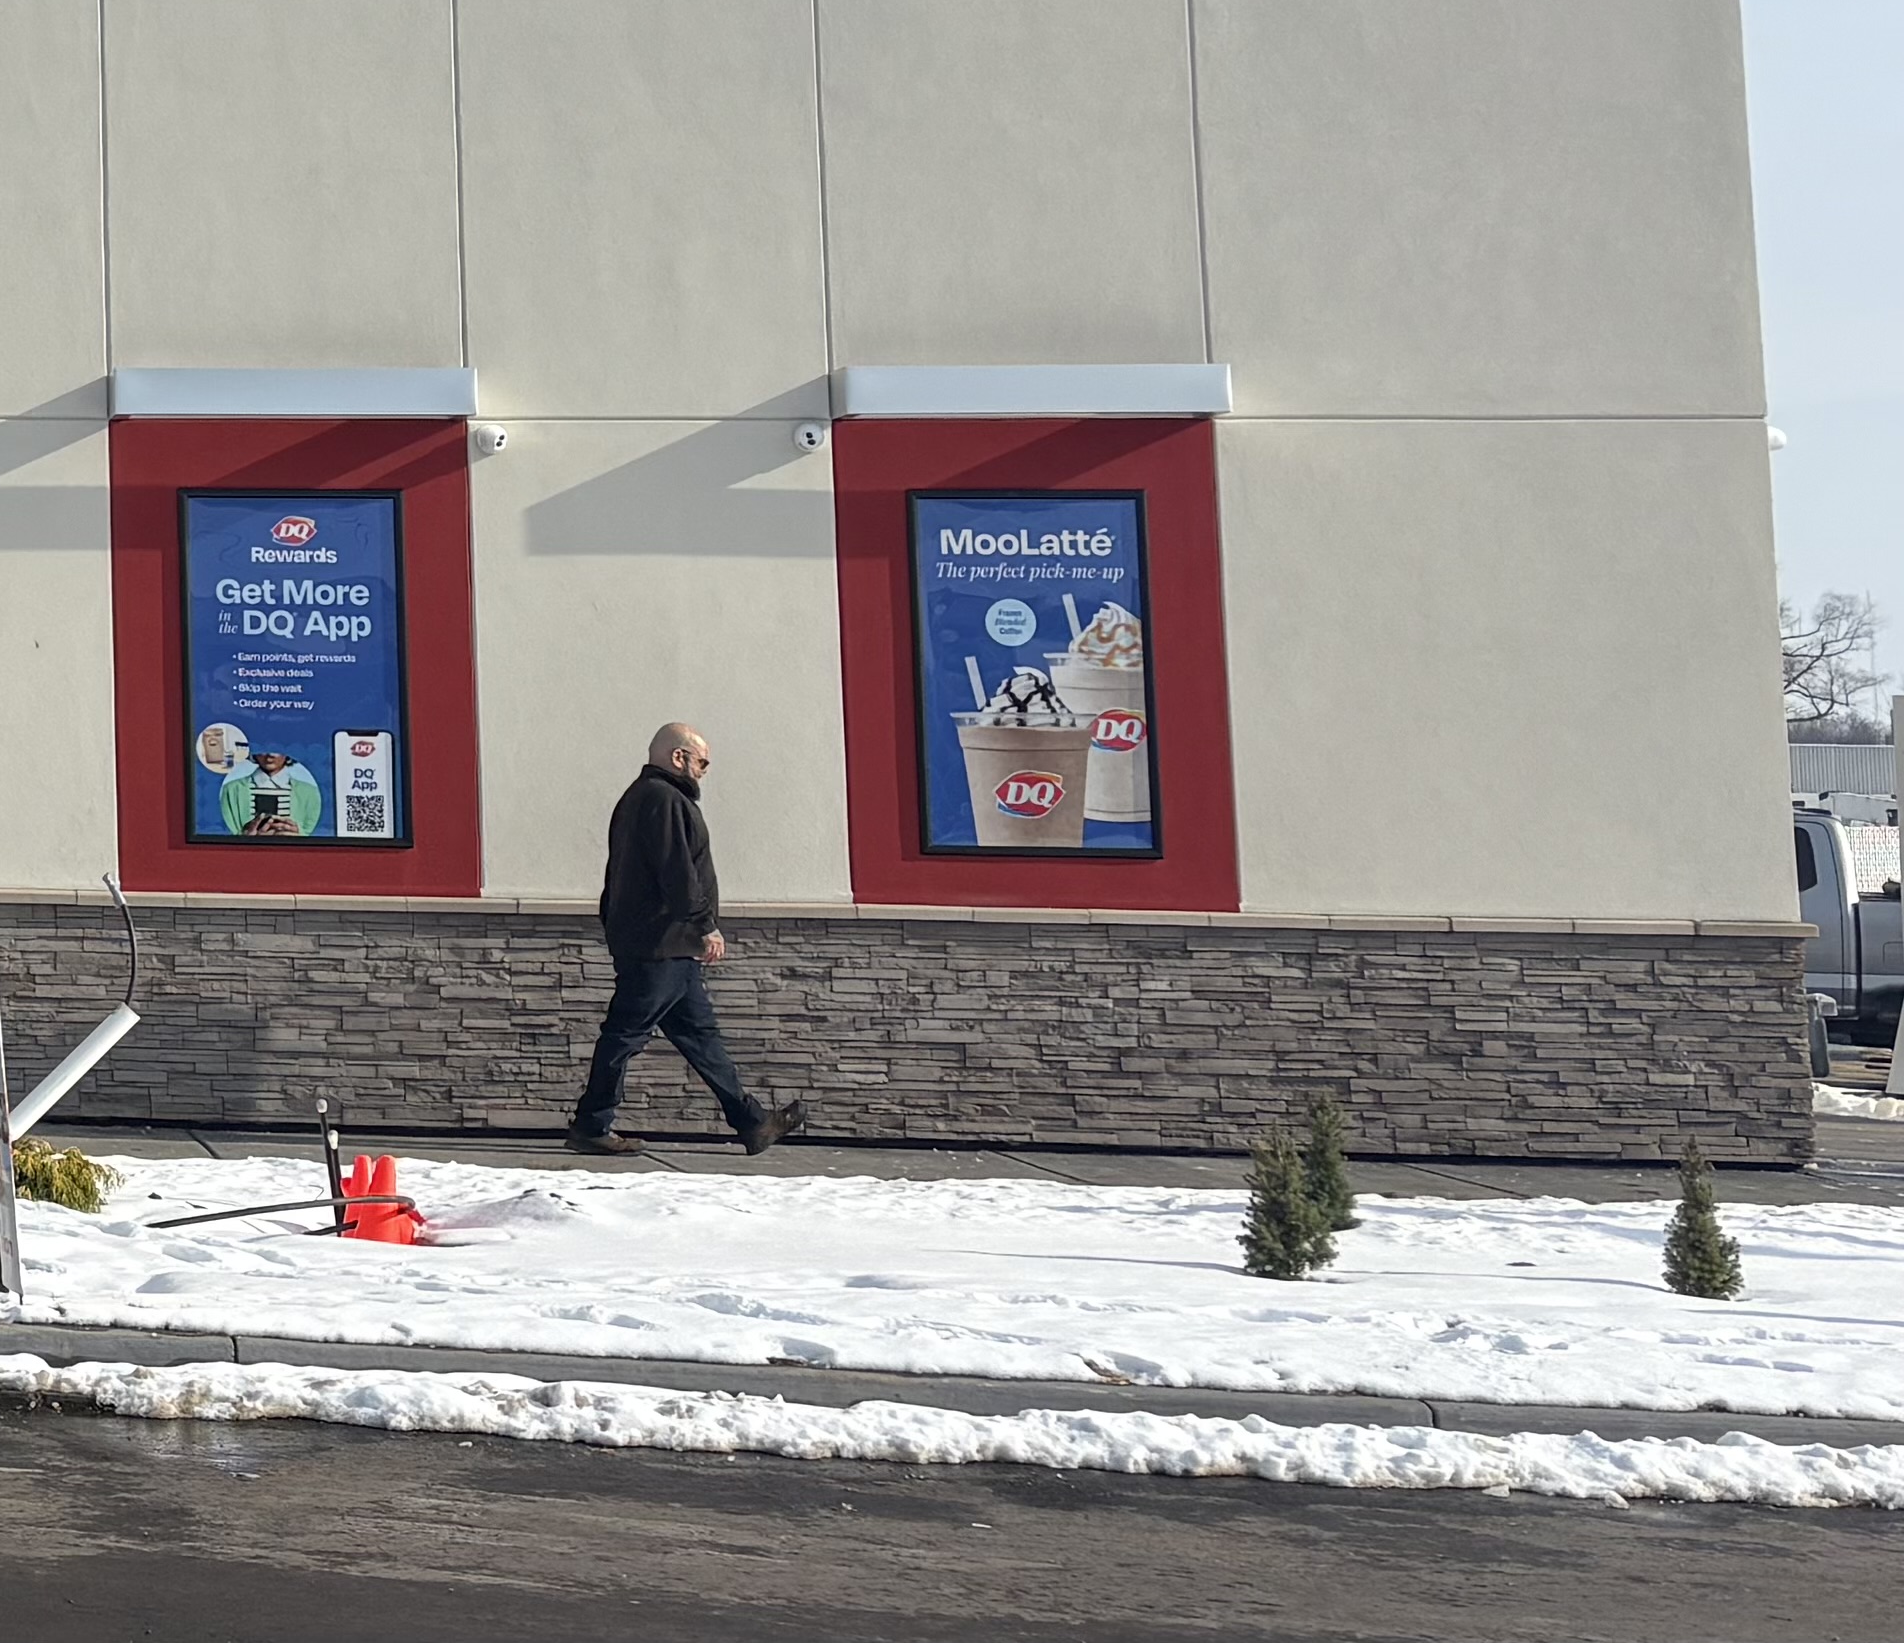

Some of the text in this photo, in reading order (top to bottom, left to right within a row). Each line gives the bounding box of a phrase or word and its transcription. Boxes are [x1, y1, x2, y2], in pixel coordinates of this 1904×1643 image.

[280, 523, 310, 539] DQ
[940, 527, 1113, 556] MooLatté
[251, 547, 338, 564] Rewards
[936, 562, 1124, 584] The perfect pick-me-up
[215, 578, 370, 606] Get More
[218, 610, 232, 622] in
[218, 622, 238, 634] the
[243, 610, 372, 642] DQ App
[1096, 718, 1144, 743] DQ
[355, 744, 372, 753] DQ
[354, 768, 374, 780] DQ
[352, 779, 378, 792] App
[1005, 782, 1055, 807] DQ
